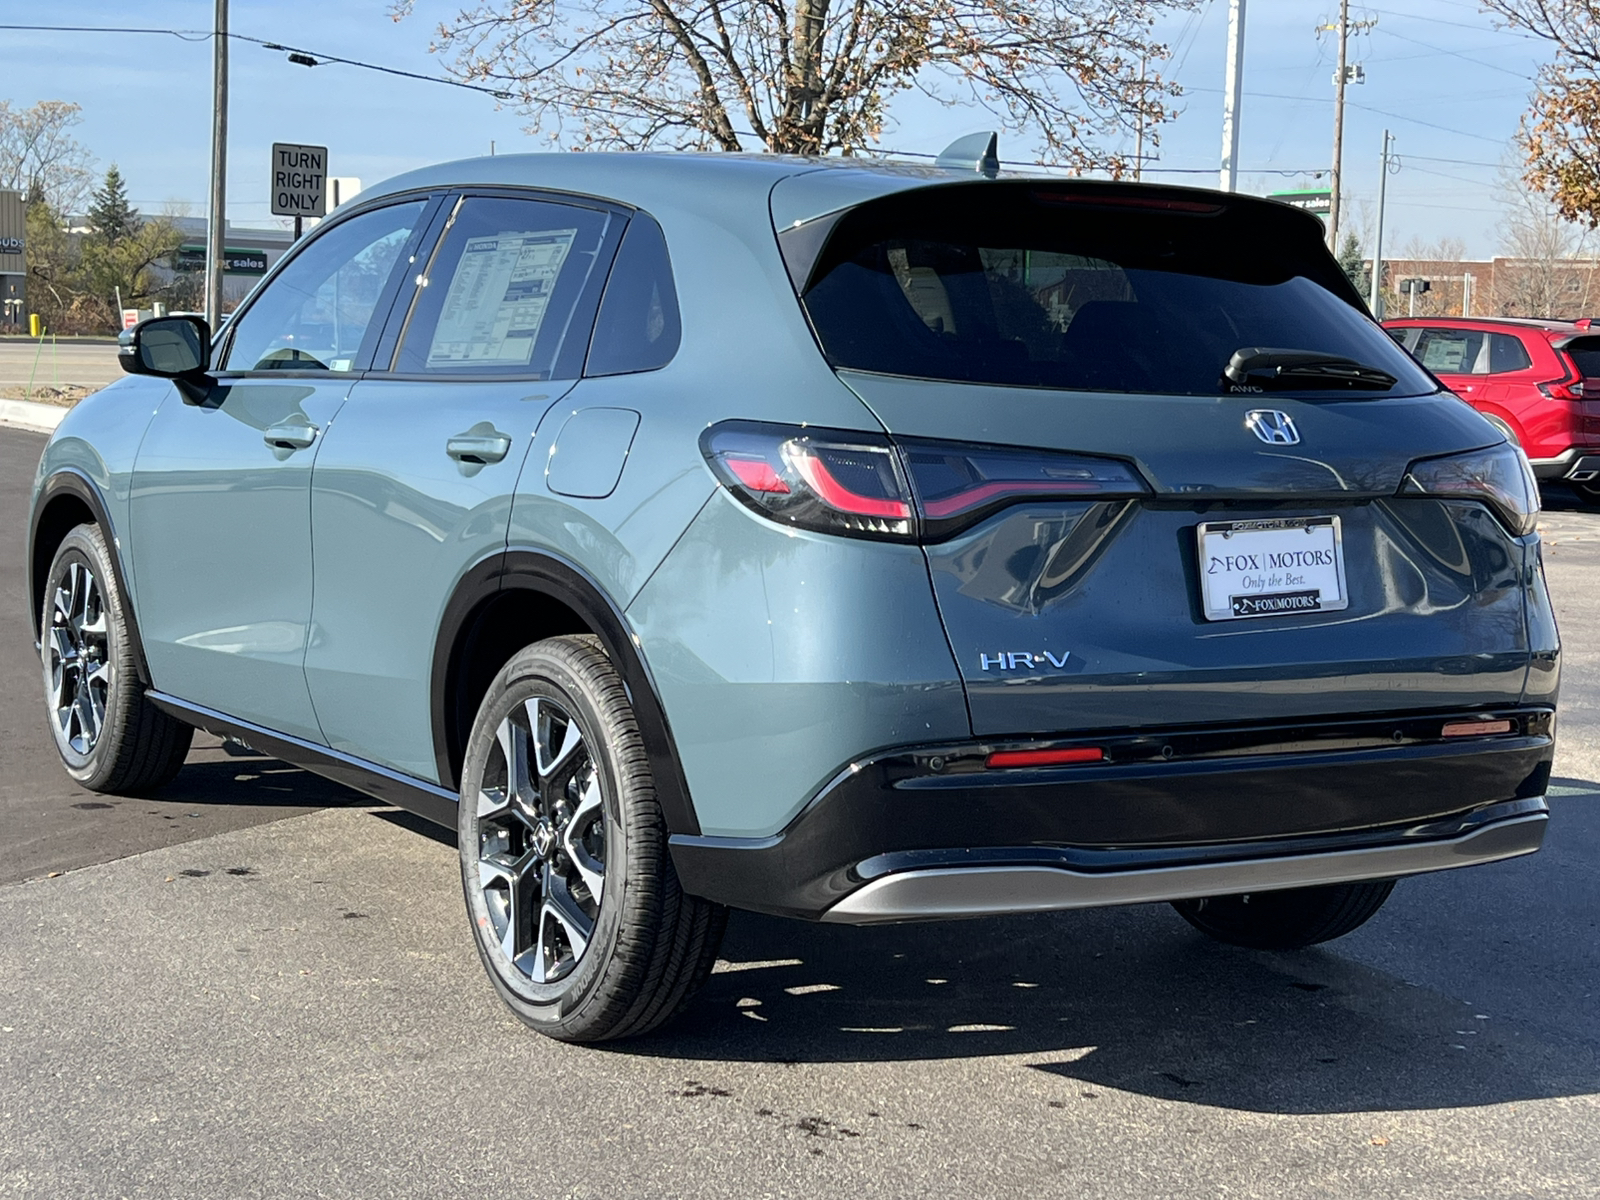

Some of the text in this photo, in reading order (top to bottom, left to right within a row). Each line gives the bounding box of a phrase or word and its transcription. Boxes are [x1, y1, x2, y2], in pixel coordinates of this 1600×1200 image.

[279, 150, 321, 170] TURN
[276, 171, 322, 190] RIGHT
[278, 192, 320, 211] ONLY
[1305, 197, 1330, 208] sales
[0, 236, 25, 248] ubs
[233, 258, 264, 269] sales
[1225, 550, 1333, 571] FOX MOTORS
[1242, 572, 1306, 592] Only the Best.
[980, 651, 1071, 671] HR-V
